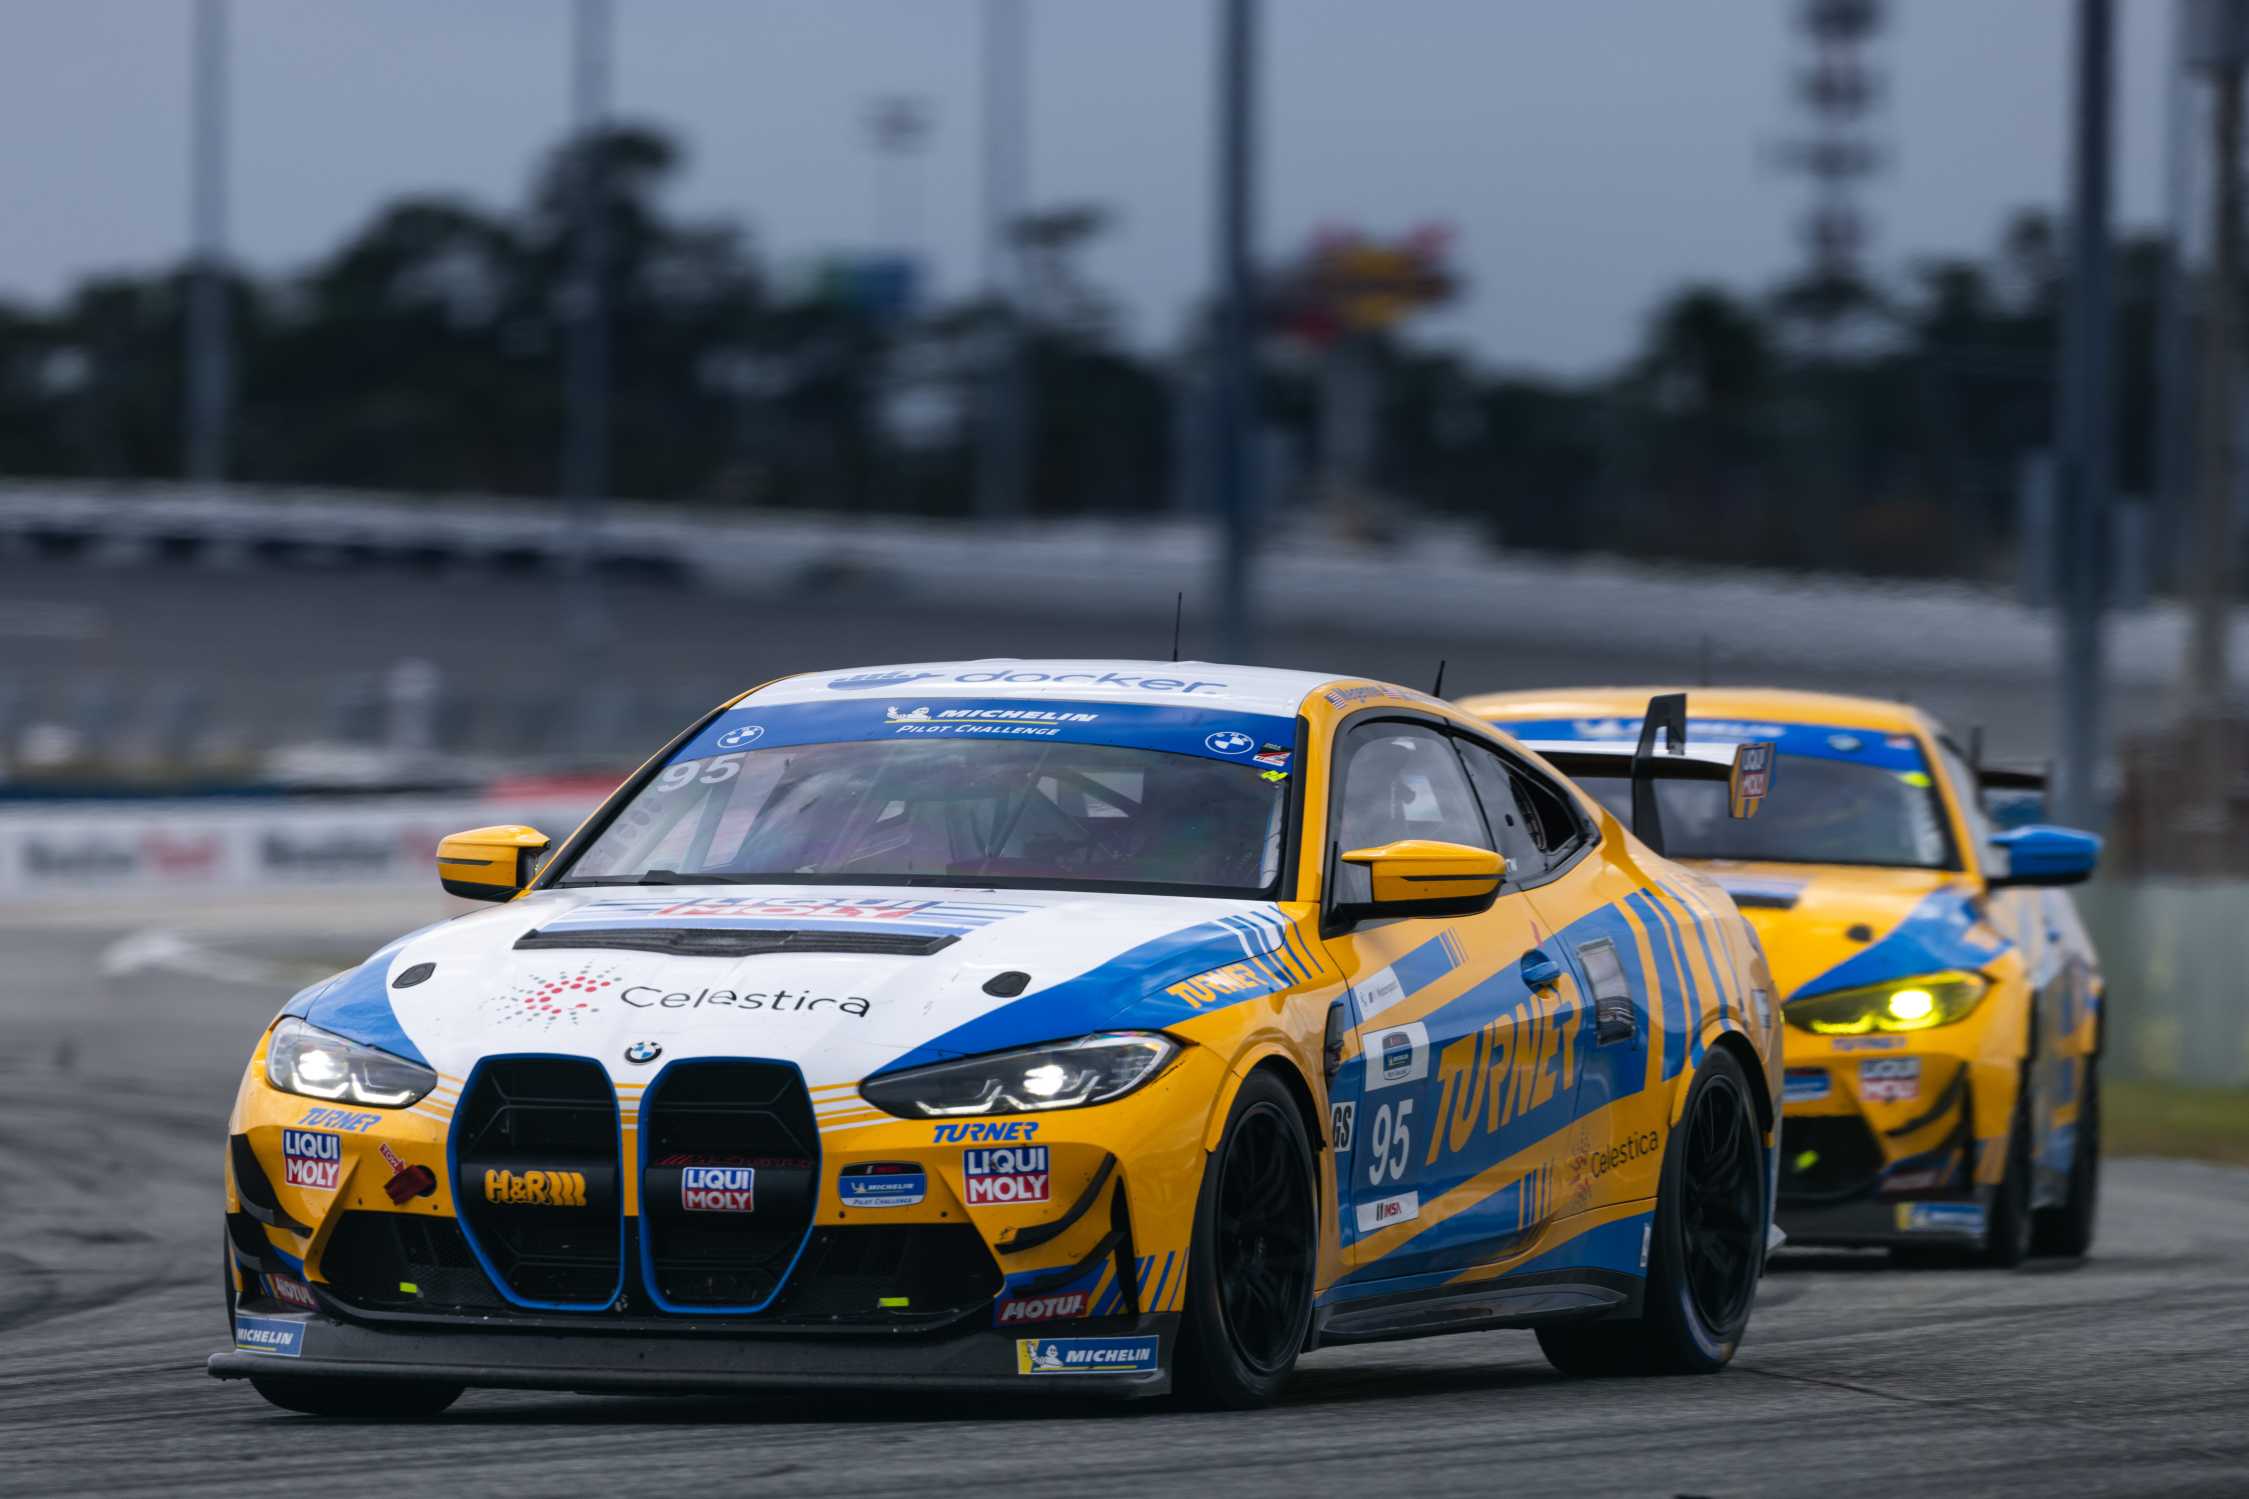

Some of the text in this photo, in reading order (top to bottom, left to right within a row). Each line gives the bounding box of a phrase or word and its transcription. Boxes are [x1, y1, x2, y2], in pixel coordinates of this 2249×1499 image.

[954, 670, 1228, 693] docker
[937, 709, 1099, 722] MICHELIN
[896, 724, 1061, 736] PILOT CHALLENGE
[656, 752, 747, 793] 95
[672, 905, 911, 918] MOLY
[620, 985, 871, 1018] Celestica
[1424, 972, 1582, 1168] TURNER
[297, 1107, 382, 1133] TURNER
[932, 1121, 1039, 1143] TURNER
[1332, 1105, 1352, 1149] GS
[285, 1131, 340, 1159] LIQUI
[1368, 1098, 1414, 1186] 95
[1590, 1130, 1659, 1178] Celestica
[286, 1158, 339, 1187] MOLY
[967, 1147, 1047, 1174] LIQUI
[484, 1169, 548, 1204] H&R
[687, 1169, 749, 1190] LIQUI
[969, 1174, 1048, 1202] MOLY
[687, 1190, 750, 1209] MOLY
[1000, 1294, 1085, 1321] MOTUL
[1065, 1348, 1151, 1363] MICHELIN
